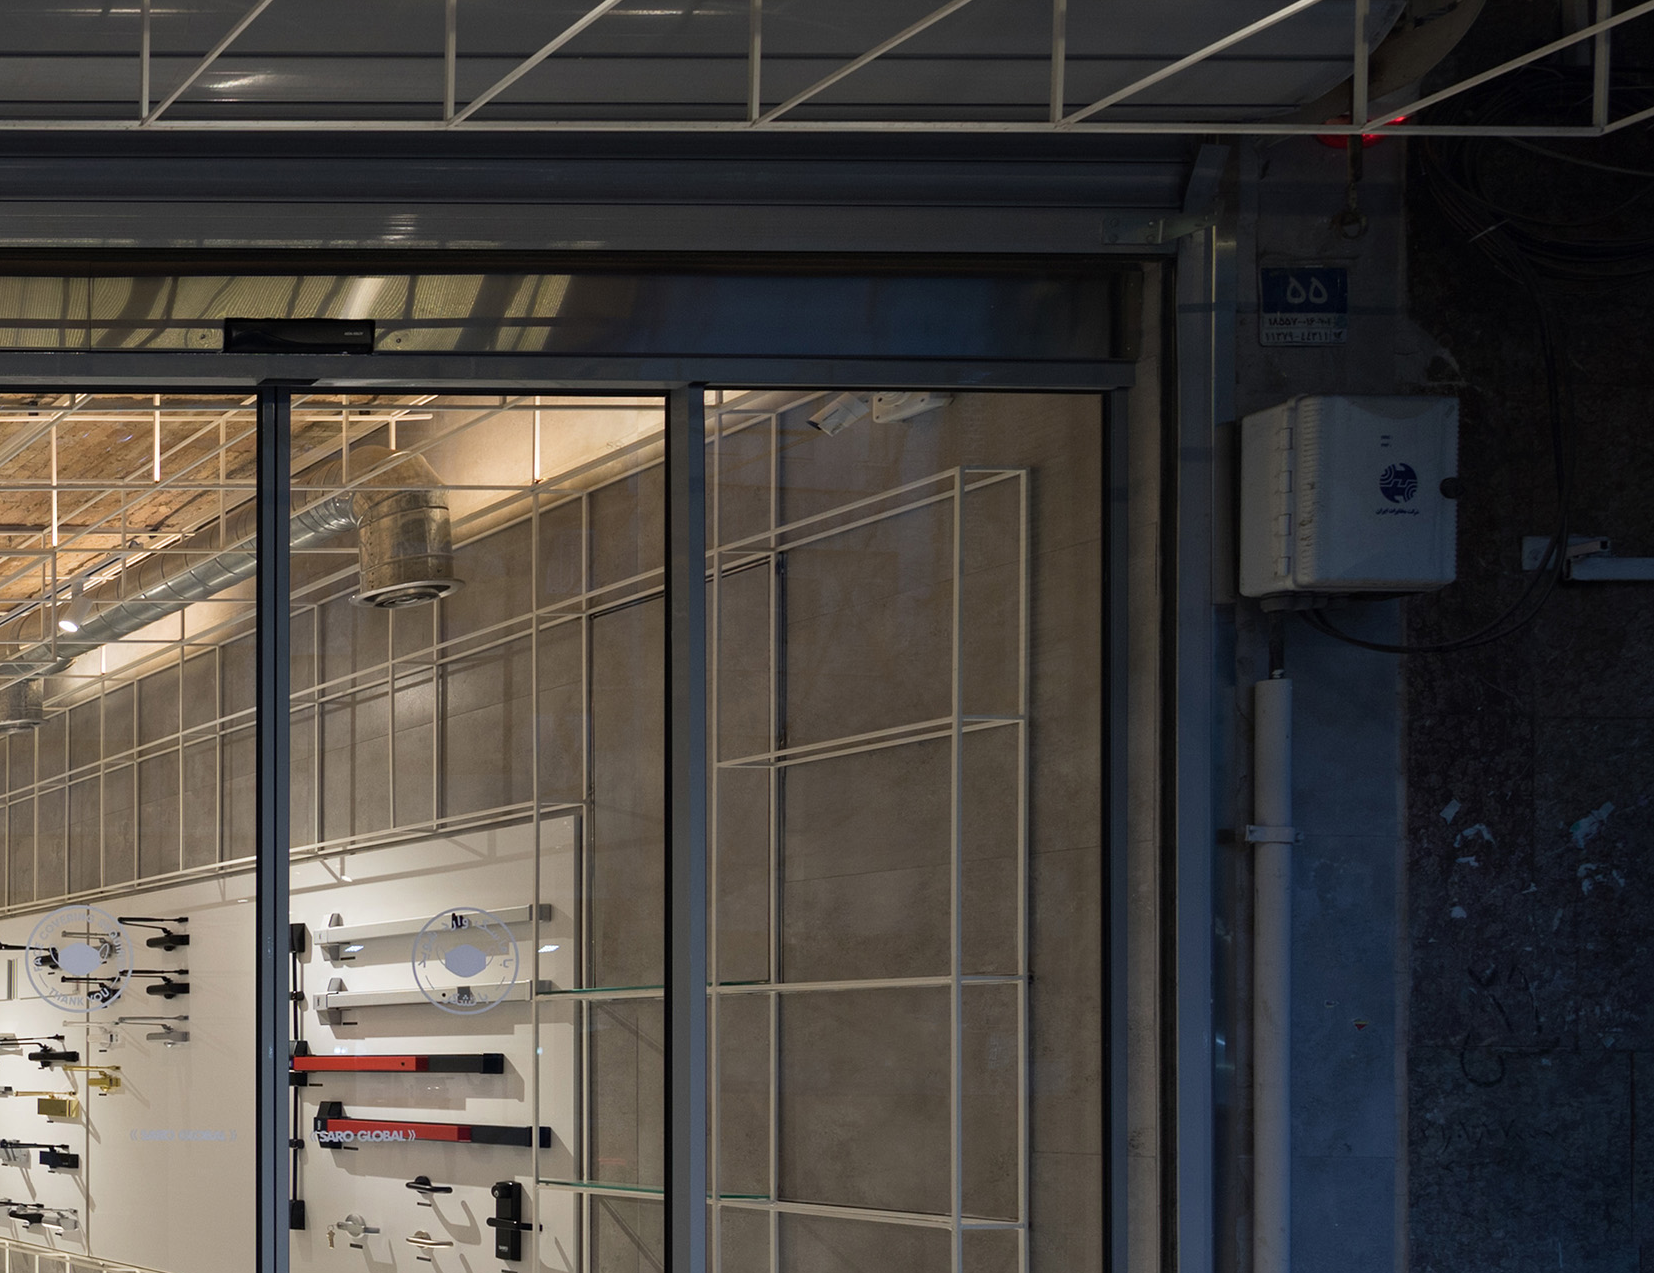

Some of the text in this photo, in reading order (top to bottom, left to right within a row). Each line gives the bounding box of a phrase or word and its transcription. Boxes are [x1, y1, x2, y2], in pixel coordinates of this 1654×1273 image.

[1286, 275, 1328, 304] ۵۵
[33, 942, 44, 973] FACE
[39, 912, 95, 940] COVERING
[49, 987, 110, 1006] THANK YOU
[319, 1129, 406, 1143] SARO GLOBAL
